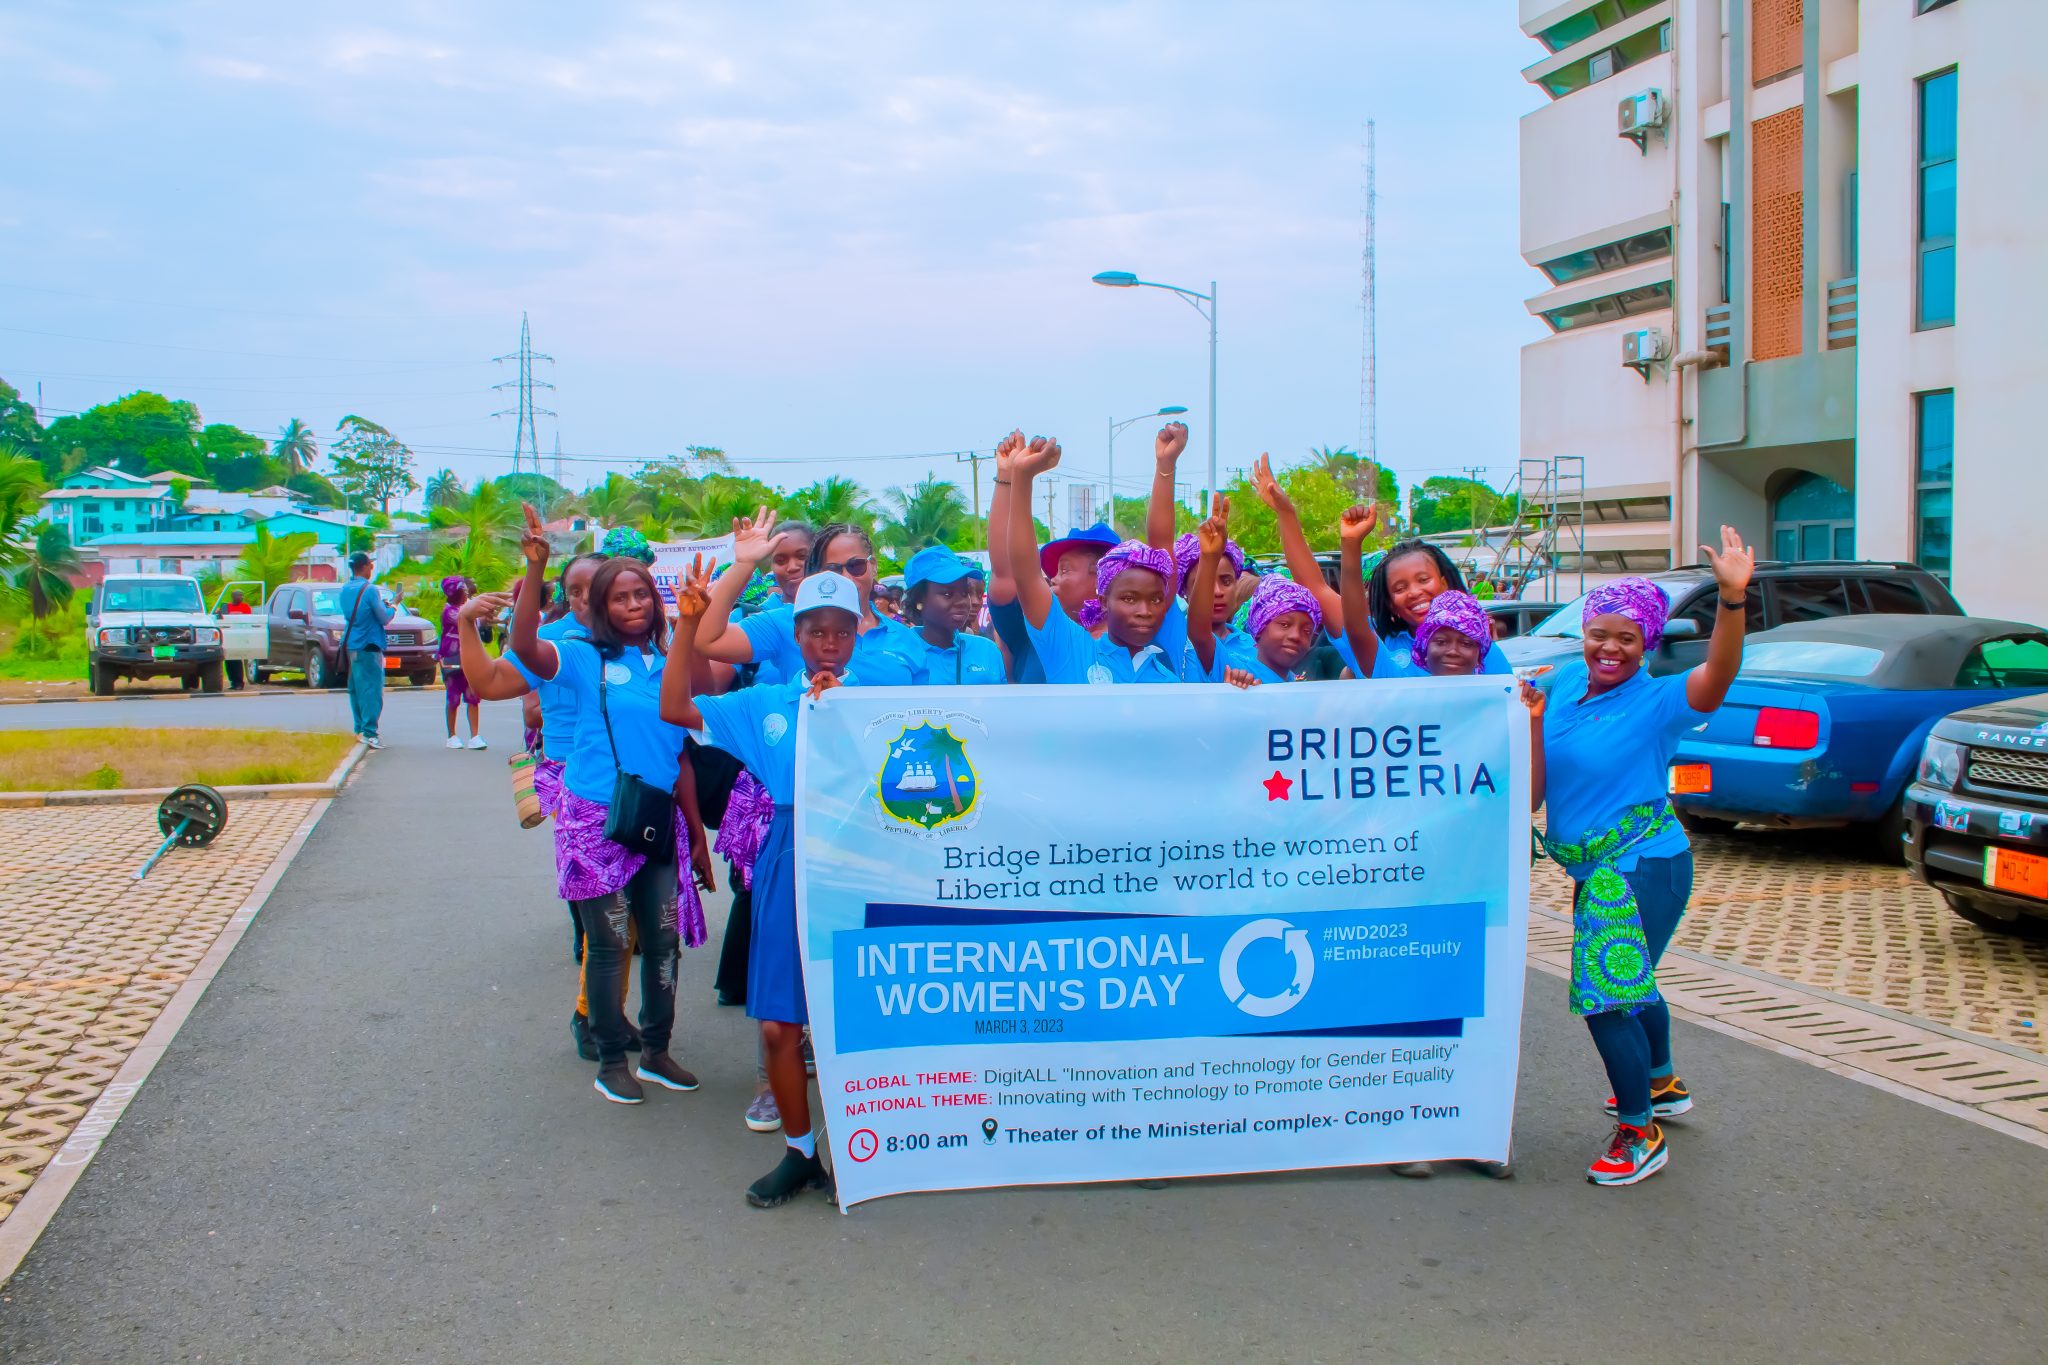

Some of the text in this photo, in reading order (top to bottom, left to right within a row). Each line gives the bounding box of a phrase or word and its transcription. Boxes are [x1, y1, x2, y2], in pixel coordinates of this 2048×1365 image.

[1268, 724, 1442, 761] BRIDGE
[1977, 731, 2047, 747] RANGE
[1301, 762, 1496, 800] LIBERIA
[884, 825, 921, 838] REPUBLIC
[939, 825, 969, 837] LIBERIA
[944, 831, 1419, 875] Bridge Liberia joins the women of
[936, 862, 1425, 900] Liberia and the world to celebrate
[1323, 923, 1408, 939] #IWD2023
[857, 933, 1204, 978] INTERNATIONAL
[1323, 940, 1462, 963] #EmbraceEquity
[875, 974, 1185, 1016] WOMEN'S DAY
[975, 1019, 1063, 1036] MARCH 3, 2023
[844, 1044, 1459, 1093] GLOBAL THEME: DigitALL "Innovation and Technology for Gender Equality"
[846, 1067, 1455, 1117] NATIONAL THEME: Innovating with Technology to Promote Gender Equality
[886, 1133, 968, 1153] 8:00 am
[1004, 1105, 1460, 1144] Theater of the Ministerial complex- Congo Town
